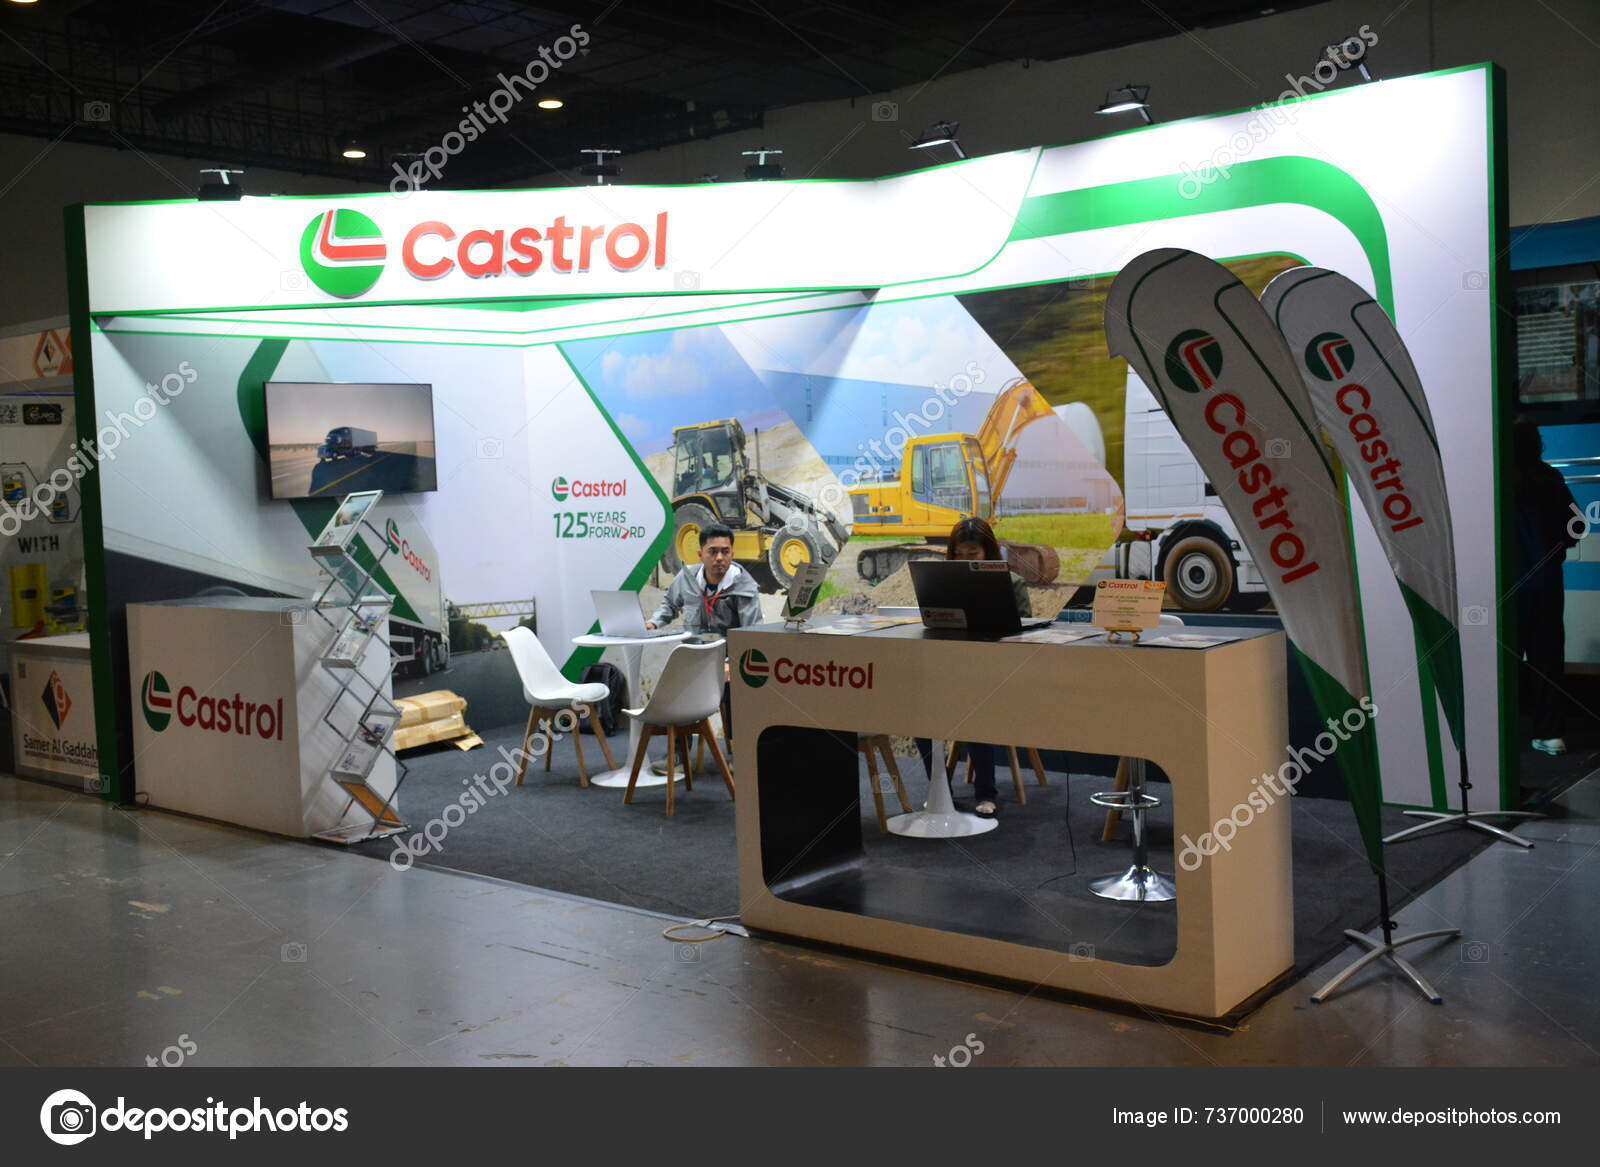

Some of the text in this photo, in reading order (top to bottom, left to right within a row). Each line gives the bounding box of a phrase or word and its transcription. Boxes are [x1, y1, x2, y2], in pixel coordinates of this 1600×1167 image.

[402, 211, 669, 281] Castrol
[1336, 383, 1425, 533] Castrol
[572, 479, 627, 497] Castrol
[1204, 392, 1321, 585] Castrol
[553, 511, 627, 539] 125 YEARS
[17, 536, 60, 554] WITH
[401, 539, 432, 584] Castrol
[1108, 581, 1139, 590] Castrol
[774, 657, 874, 690] Castrol
[176, 685, 284, 741] Castrol
[23, 733, 50, 752] Samer
[52, 738, 62, 754] Al
